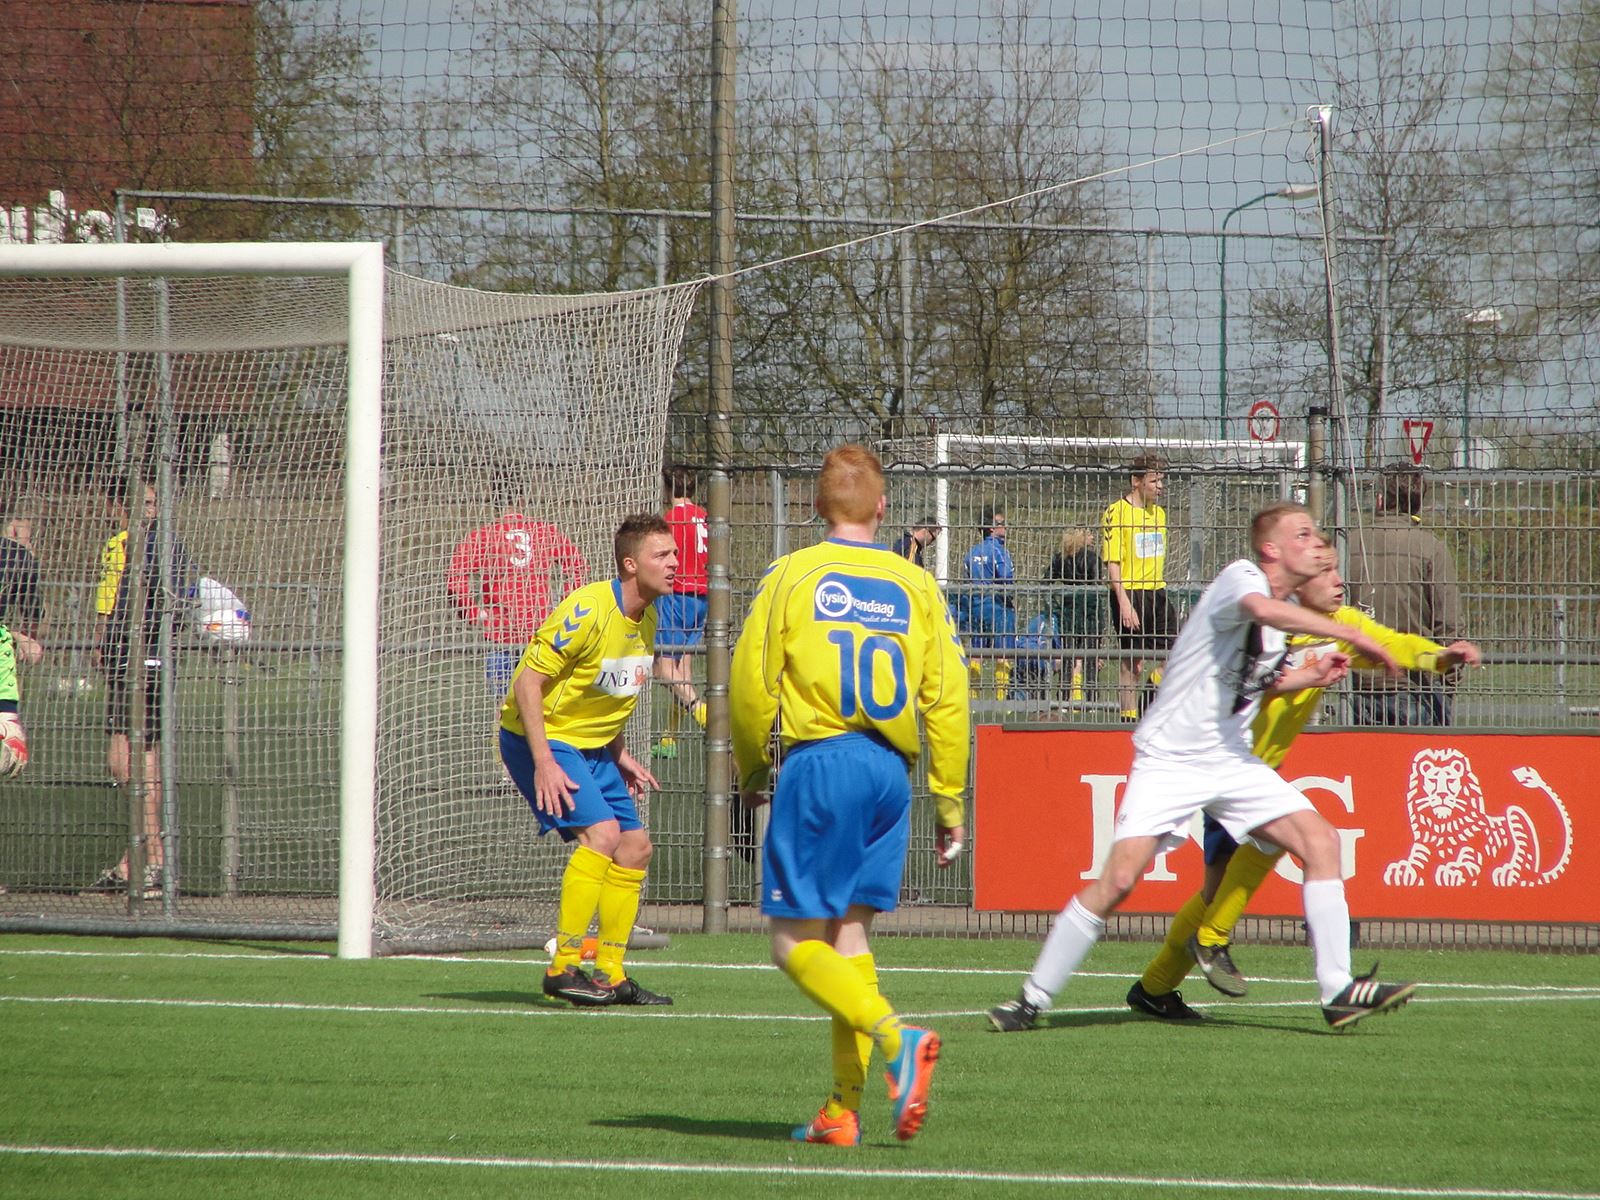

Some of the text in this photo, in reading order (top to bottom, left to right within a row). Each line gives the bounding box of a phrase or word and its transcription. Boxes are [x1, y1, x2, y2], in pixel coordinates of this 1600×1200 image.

[505, 529, 532, 567] 3
[597, 669, 628, 688] ING
[827, 629, 908, 721] 10
